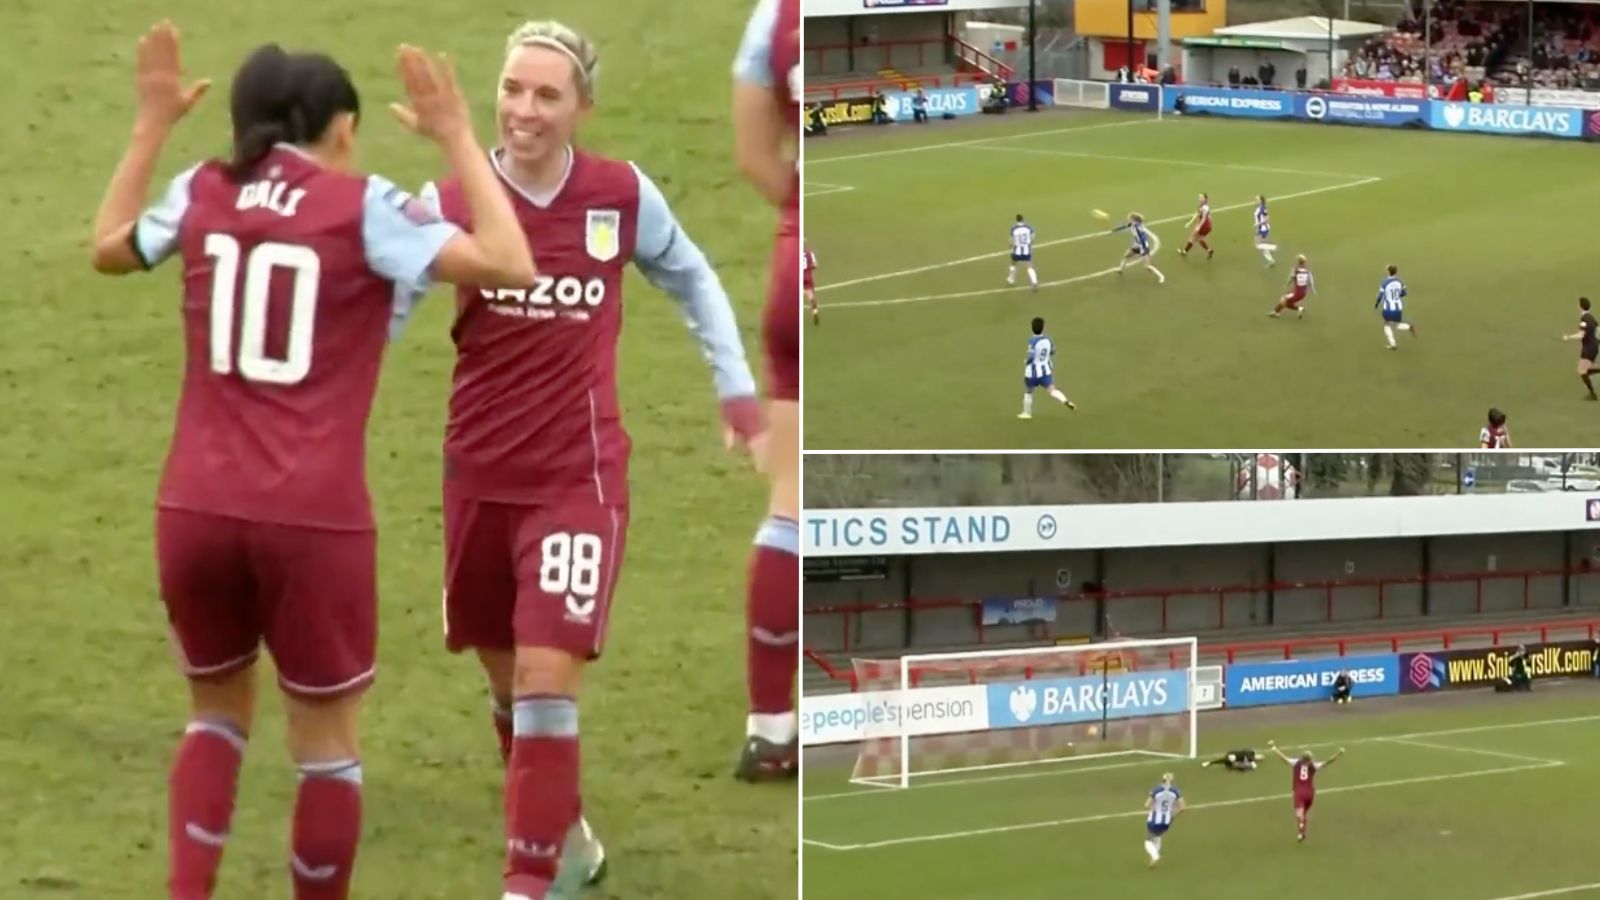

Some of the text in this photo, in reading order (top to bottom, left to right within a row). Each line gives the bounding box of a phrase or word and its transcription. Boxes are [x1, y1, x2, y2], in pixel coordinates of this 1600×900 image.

[902, 92, 967, 115] BCLAYS
[1468, 107, 1570, 132] BARCLAYS
[204, 233, 321, 385] 10
[808, 515, 1010, 547] TICS STAND
[539, 531, 602, 596] 88
[1043, 678, 1168, 715] BARCLAYS
[1240, 668, 1385, 693] AMERICAN EXRESS
[812, 700, 897, 734] people's
